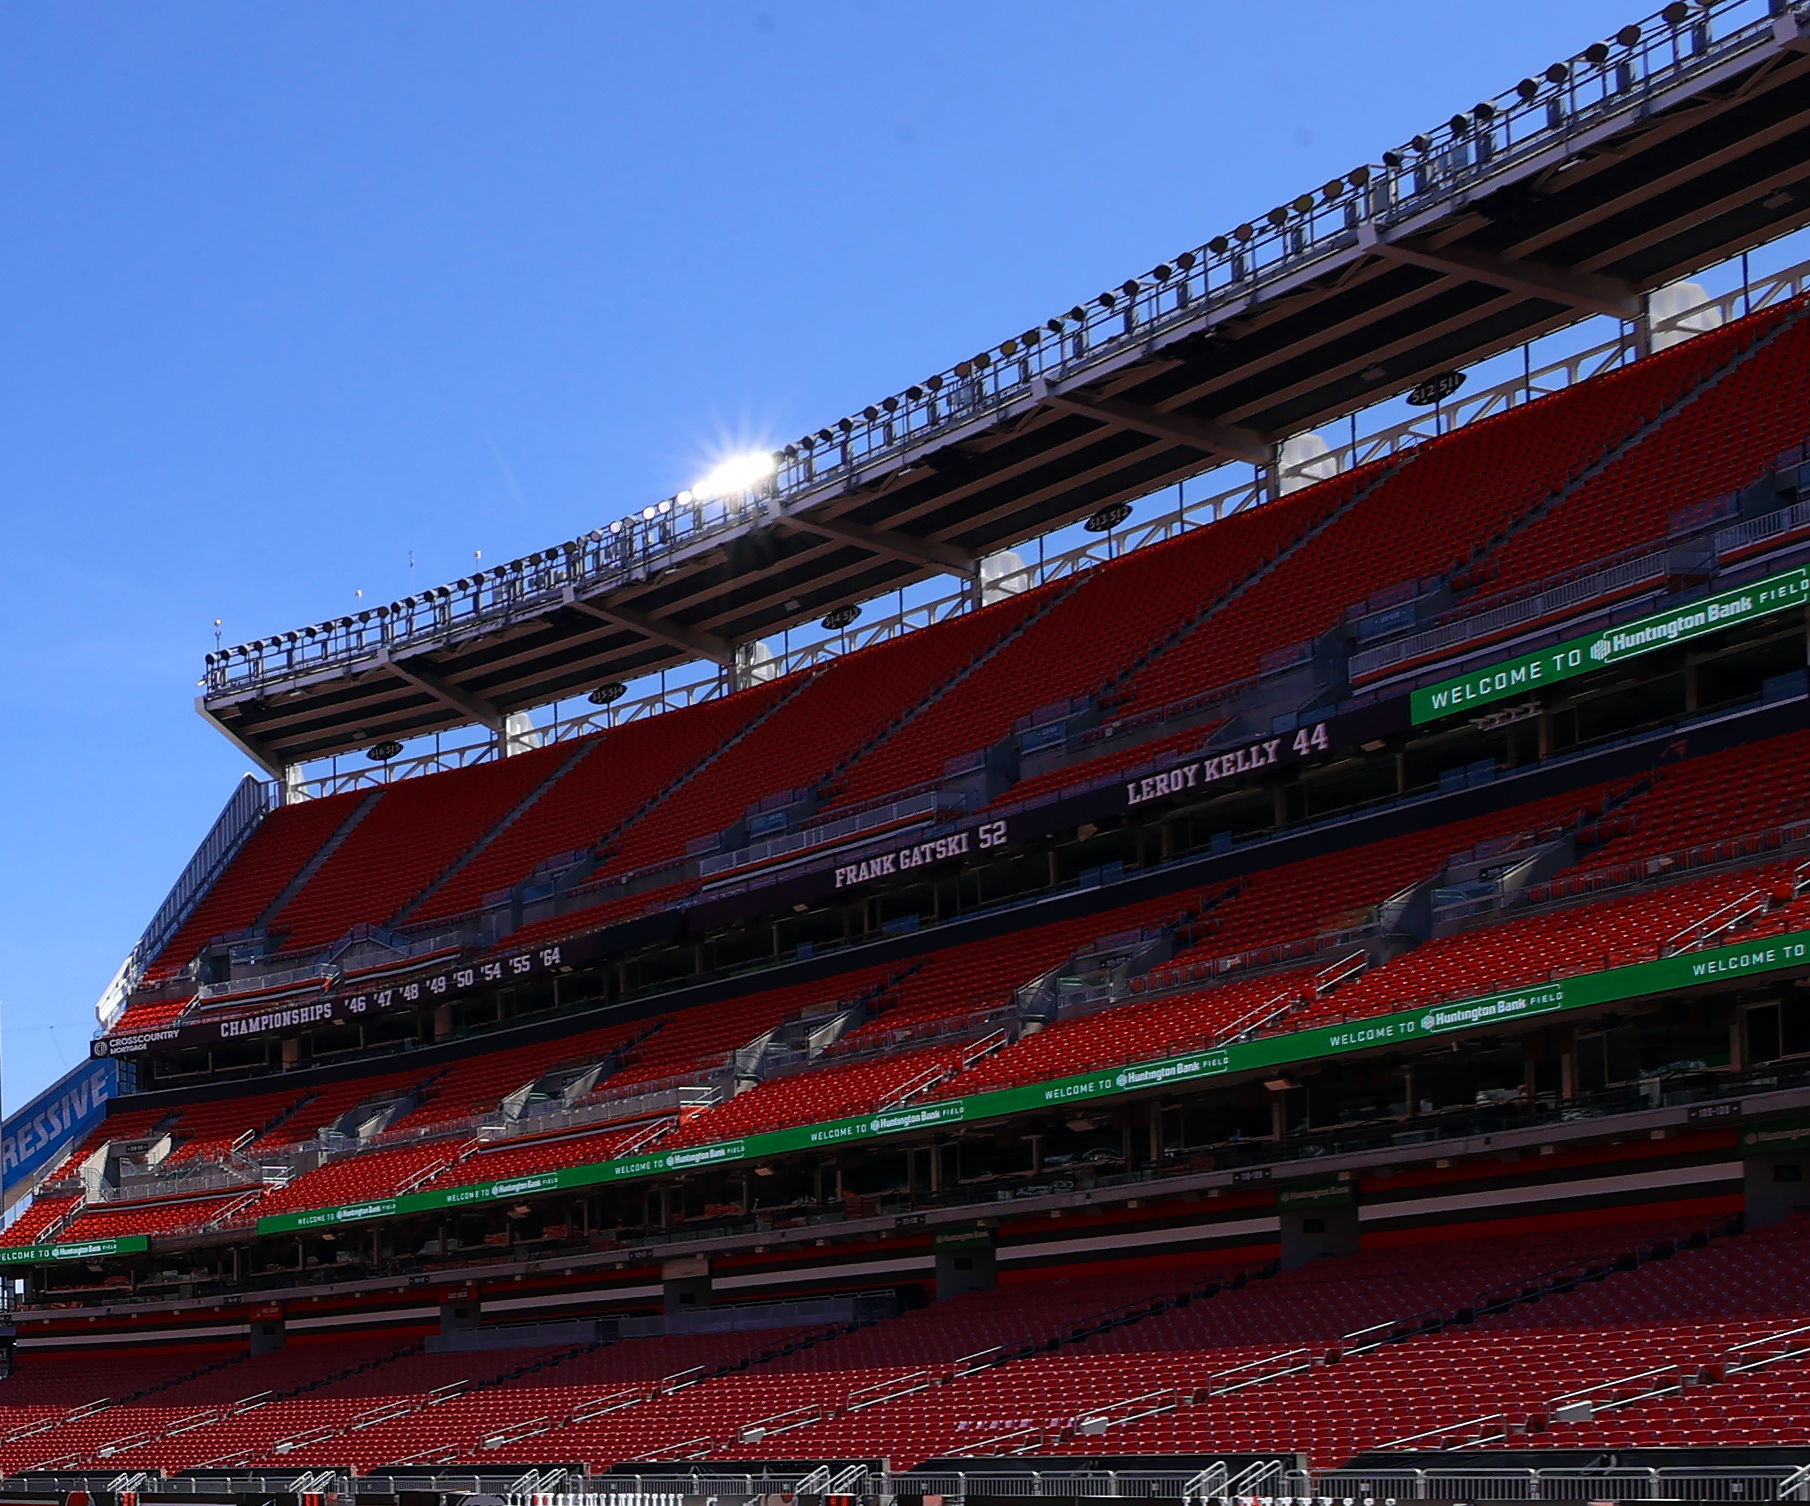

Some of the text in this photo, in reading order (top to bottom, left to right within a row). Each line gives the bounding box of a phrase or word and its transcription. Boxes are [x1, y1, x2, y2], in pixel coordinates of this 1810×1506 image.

[1432, 579, 1810, 709] WELCOME TO Huntington Bank FIELD
[1127, 723, 1328, 805] LEROY KELLY 44
[835, 821, 1007, 888] FRANK GATSKI 52
[1692, 944, 1804, 977] WELCOME TO
[221, 947, 561, 1038] CHAMPIONSHIPS '46 '47 '48 '49 '50 '54 '55 '64
[110, 1030, 179, 1047] CROSSCOUNTRY
[1329, 992, 1563, 1047] WELCOME TO Huntington Bank FIELD
[1045, 1057, 1229, 1100] WELCOME TO Huntington Bank FIELD
[810, 1110, 940, 1142] WELCOME TO Huntington Bank
[615, 1159, 663, 1176] WELCOME TO
[447, 1191, 479, 1202] WELCOME
[298, 1214, 325, 1225] WELCOME
